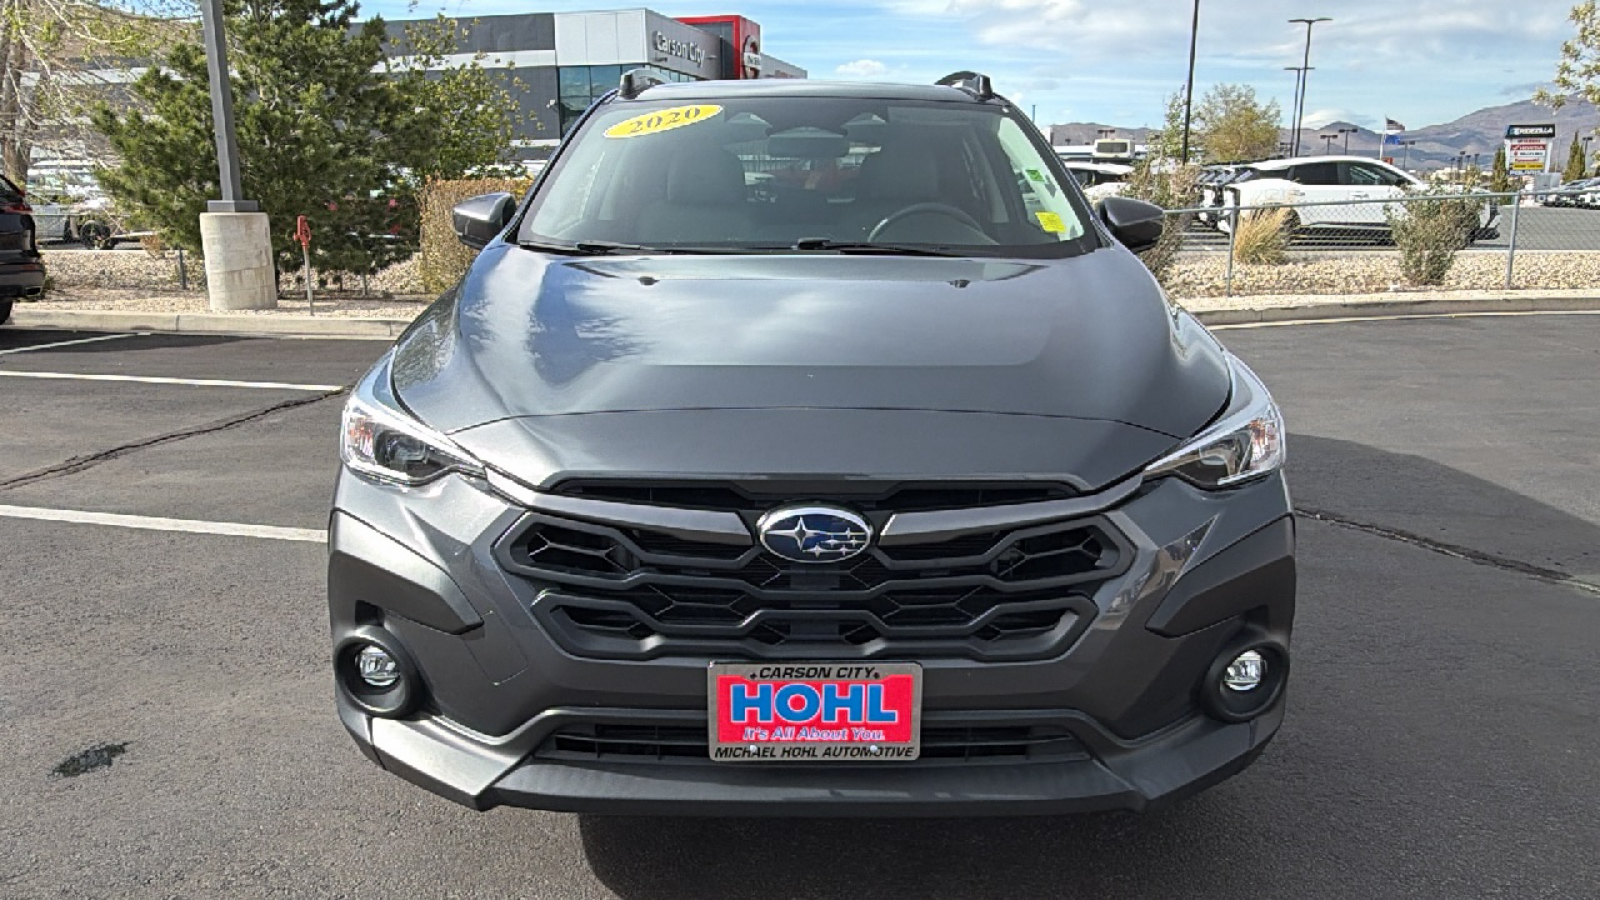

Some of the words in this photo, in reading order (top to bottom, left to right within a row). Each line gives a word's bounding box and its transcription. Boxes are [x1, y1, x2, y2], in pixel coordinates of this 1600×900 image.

[654, 30, 688, 59] Carson
[689, 41, 706, 68] City
[628, 107, 701, 134] 2020
[759, 667, 831, 679] CARSON
[836, 666, 876, 678] CITY
[730, 683, 898, 723] HOHL
[743, 726, 767, 740] It's
[770, 726, 795, 740] All
[798, 726, 848, 740] About
[714, 746, 777, 758] MICHAEL
[781, 746, 819, 758] HOHL
[822, 746, 915, 758] AUTOMOTIVE
